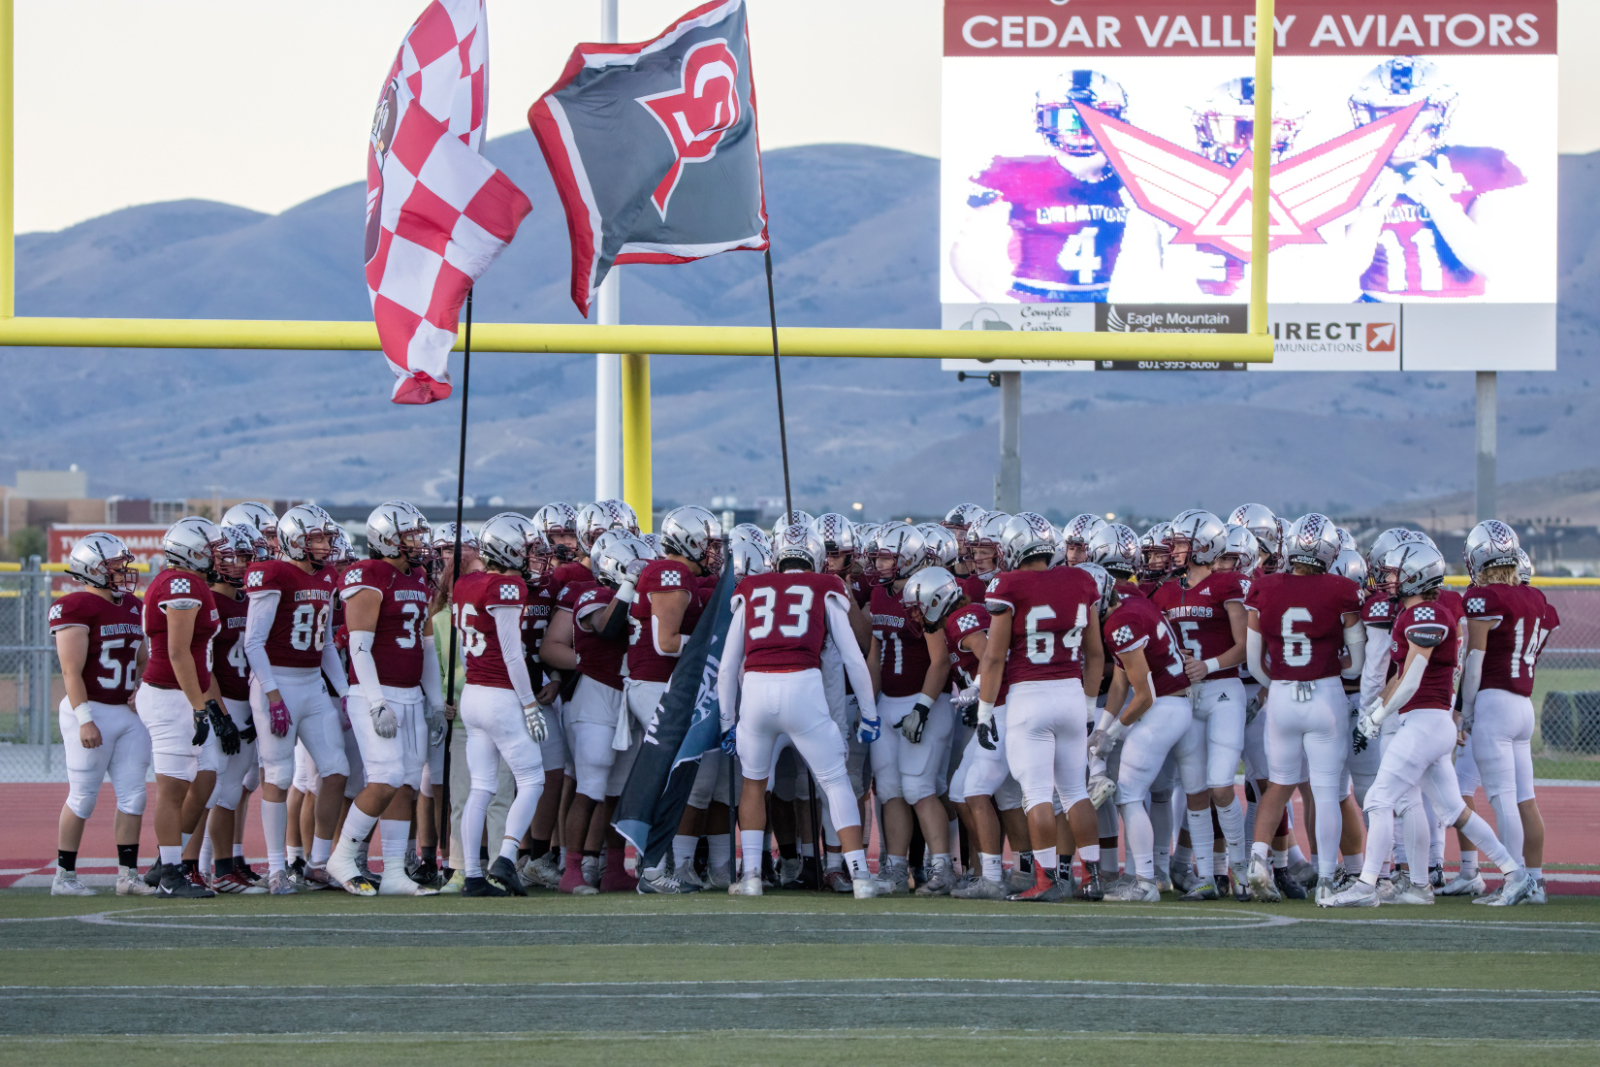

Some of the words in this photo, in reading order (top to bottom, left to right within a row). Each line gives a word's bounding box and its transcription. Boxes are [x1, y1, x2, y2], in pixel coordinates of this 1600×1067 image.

[962, 15, 1122, 48] CEDAR
[1309, 13, 1539, 47] AVIATORS
[1057, 226, 1101, 284] 4
[1021, 306, 1073, 320] Complete
[1127, 312, 1163, 327] Eagle
[1166, 312, 1230, 325] Mountain
[1267, 322, 1361, 340] IRECT
[749, 585, 814, 640] 33
[1025, 603, 1088, 665] 64
[1178, 621, 1202, 661] 5
[1280, 607, 1312, 667] 6
[1511, 616, 1540, 678] 14
